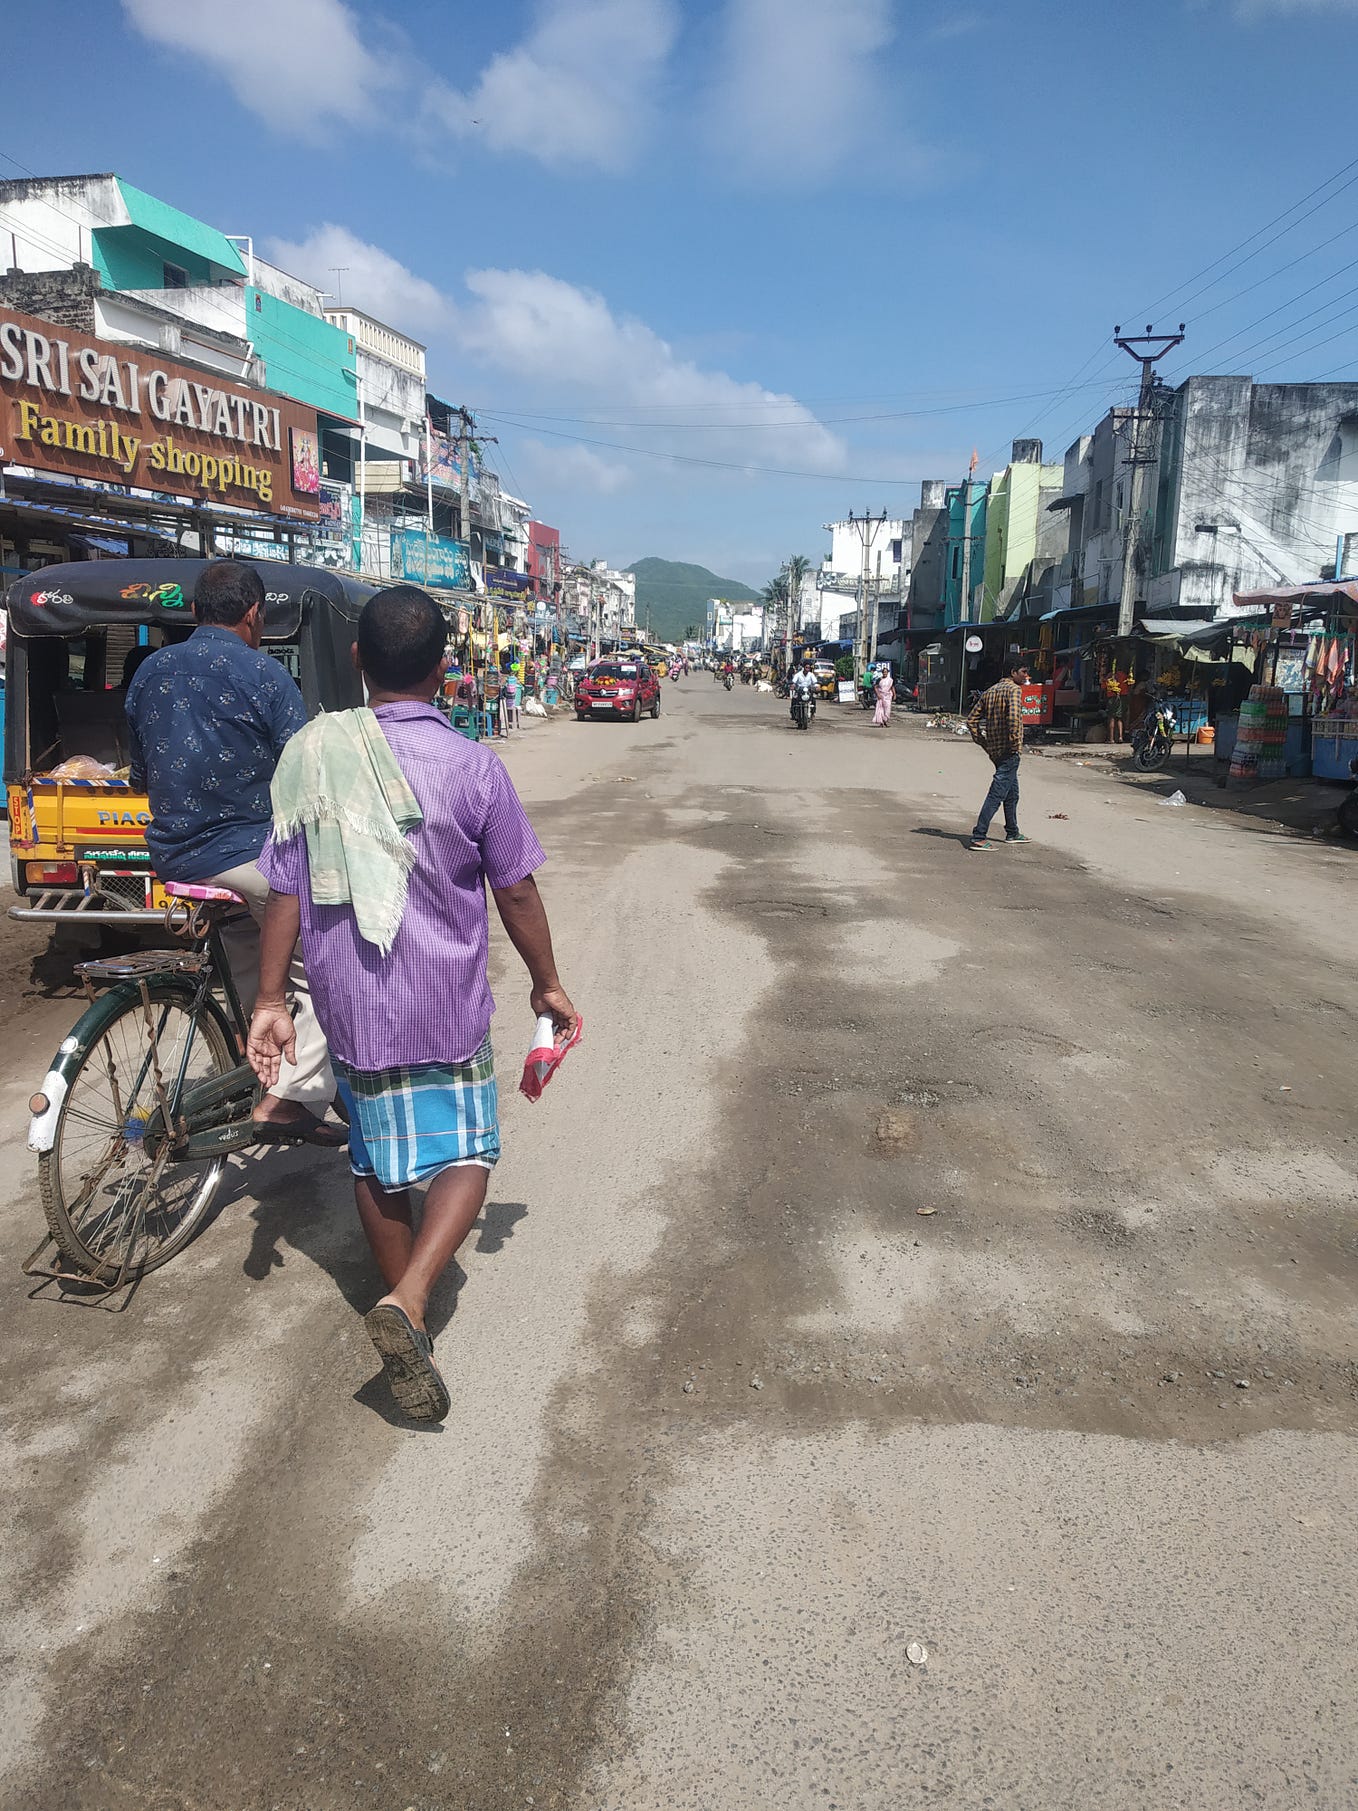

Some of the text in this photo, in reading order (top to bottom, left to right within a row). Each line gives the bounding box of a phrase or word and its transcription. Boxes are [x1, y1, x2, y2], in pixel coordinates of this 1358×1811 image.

[0, 322, 282, 451] SRI SAI GAYATRI
[16, 400, 274, 503] Family shopping
[13, 797, 21, 834] STOP
[97, 810, 151, 826] PIAG
